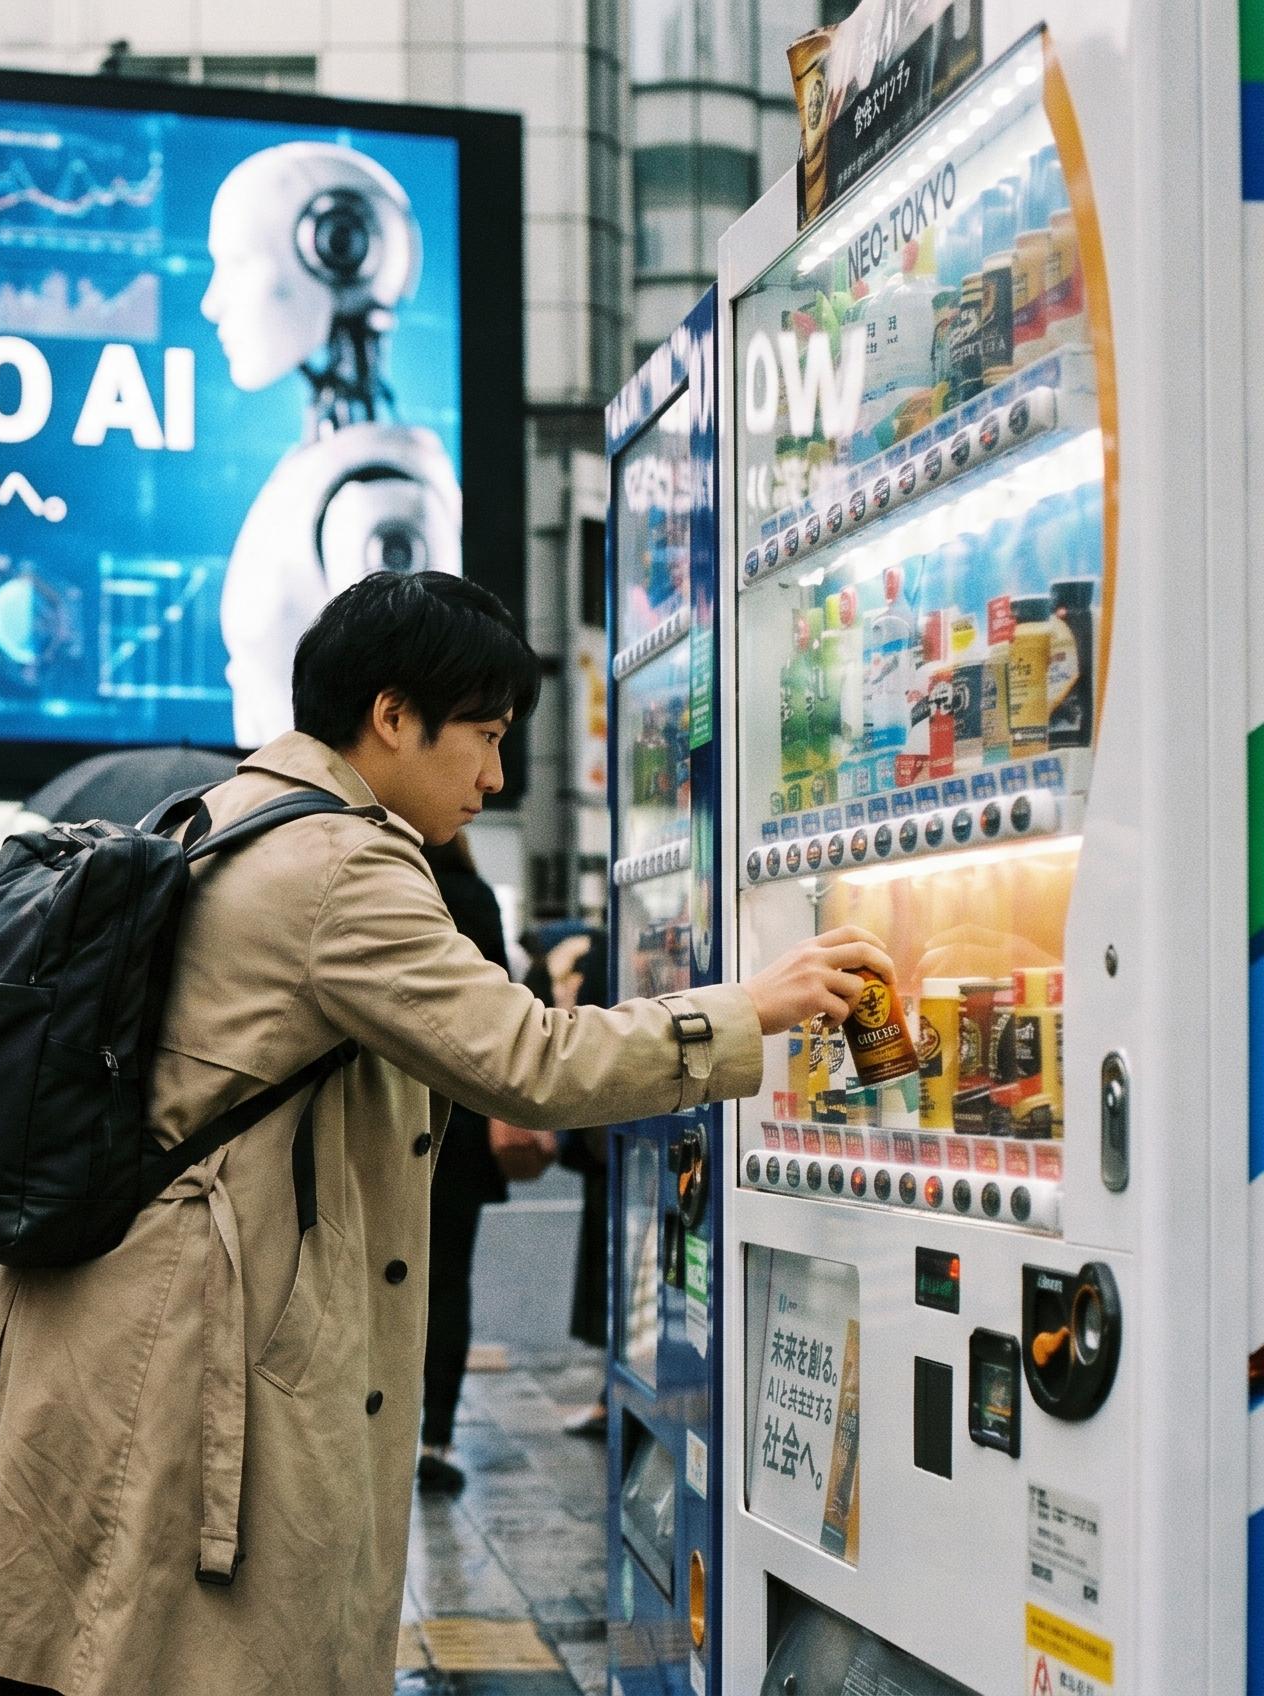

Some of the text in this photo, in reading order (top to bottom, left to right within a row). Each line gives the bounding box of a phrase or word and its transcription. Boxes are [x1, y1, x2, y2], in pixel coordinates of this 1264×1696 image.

[848, 161, 956, 289] NEO-TOKYO
[72, 343, 196, 452] AI
[770, 1328, 838, 1387] 未来を創る。
[762, 1414, 823, 1491] 社会へ。
